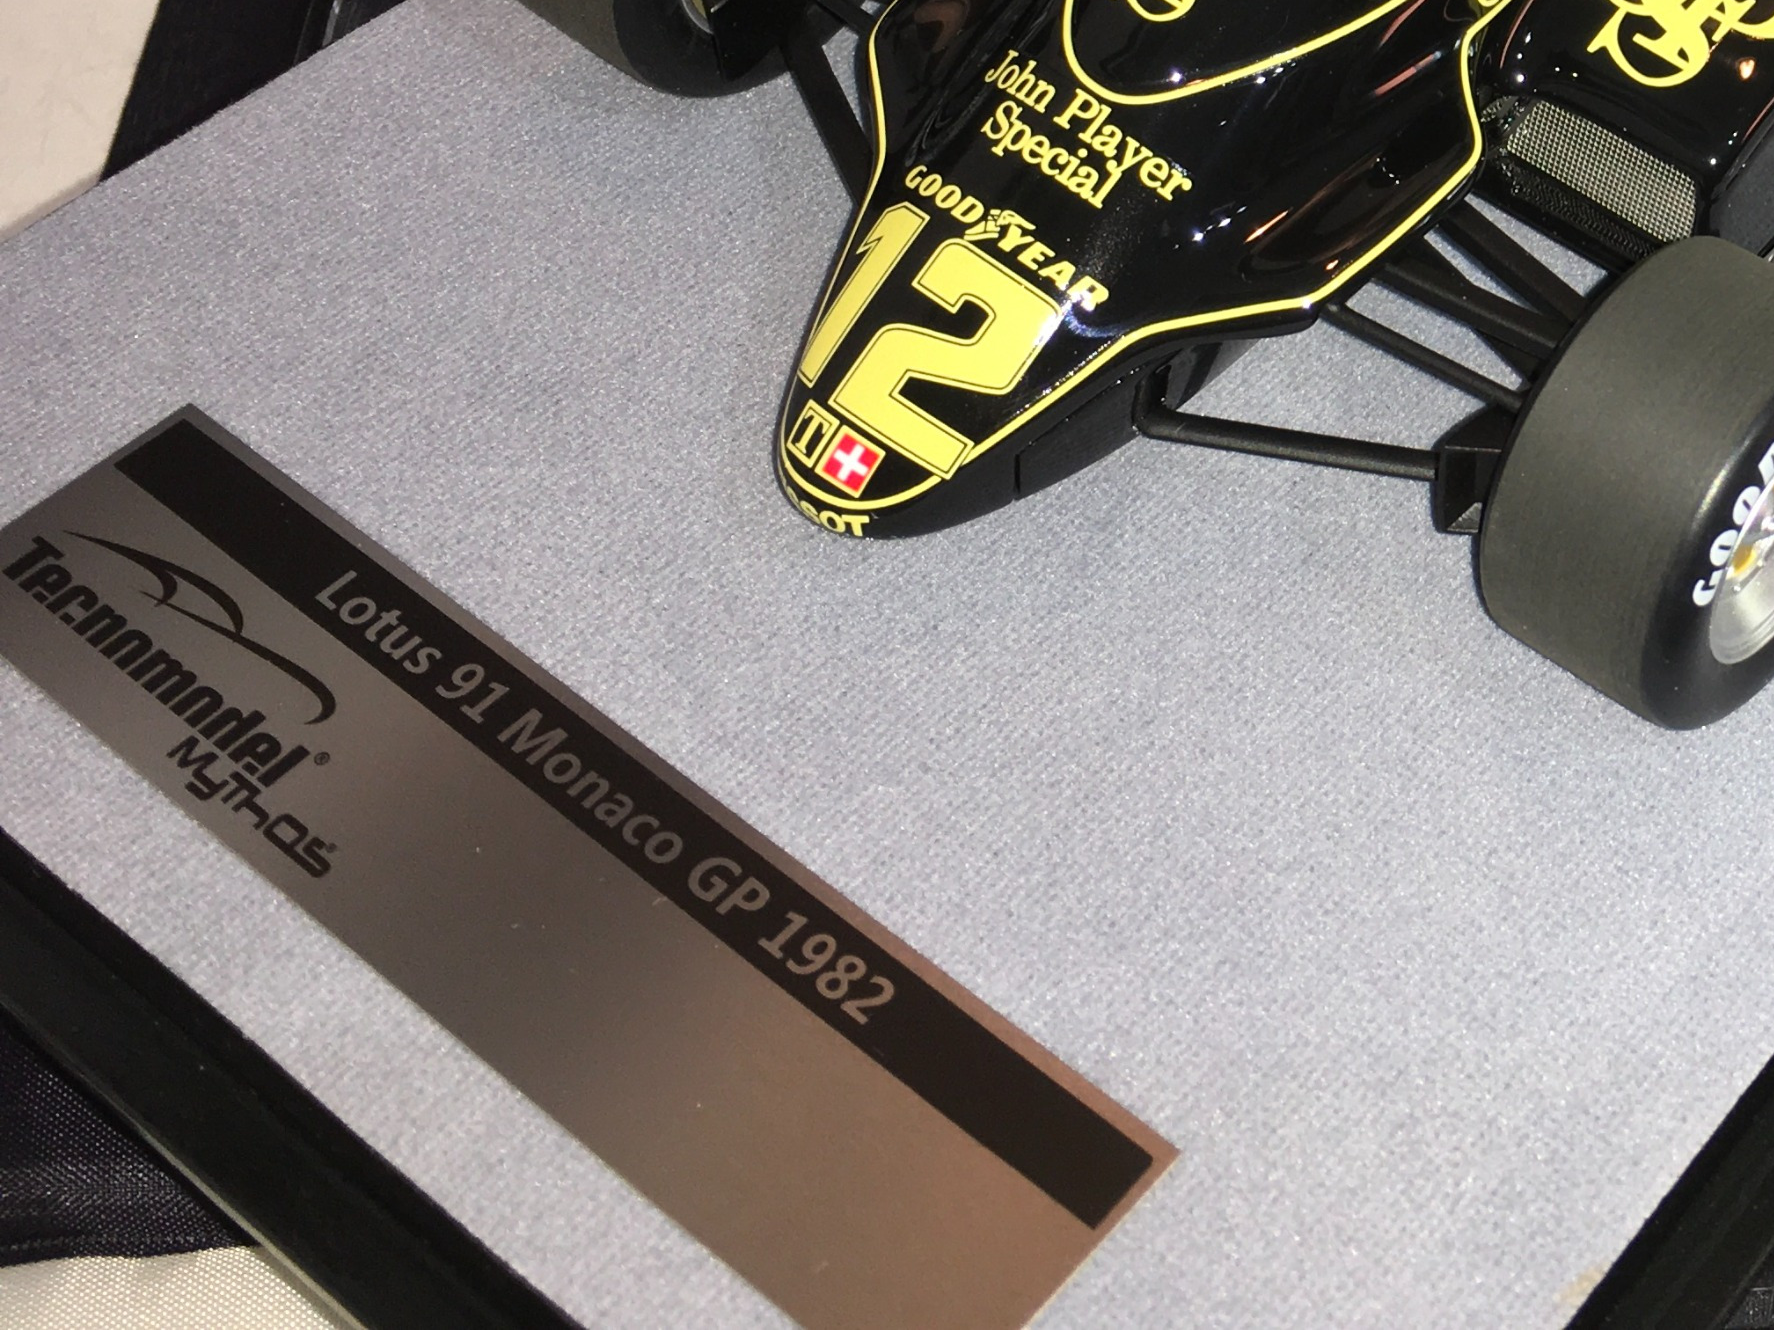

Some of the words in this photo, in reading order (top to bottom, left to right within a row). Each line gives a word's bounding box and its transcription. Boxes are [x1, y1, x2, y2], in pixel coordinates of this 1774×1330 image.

[980, 101, 1123, 210] Special
[984, 49, 1056, 114] John
[1053, 88, 1193, 202] Player
[905, 164, 1110, 312] GOODYEAR
[797, 201, 1066, 481] 12
[315, 570, 442, 675] Lotus
[435, 662, 511, 724] 91
[498, 708, 684, 864] Monaco
[688, 856, 771, 916] GP
[759, 911, 896, 1025] 1982
